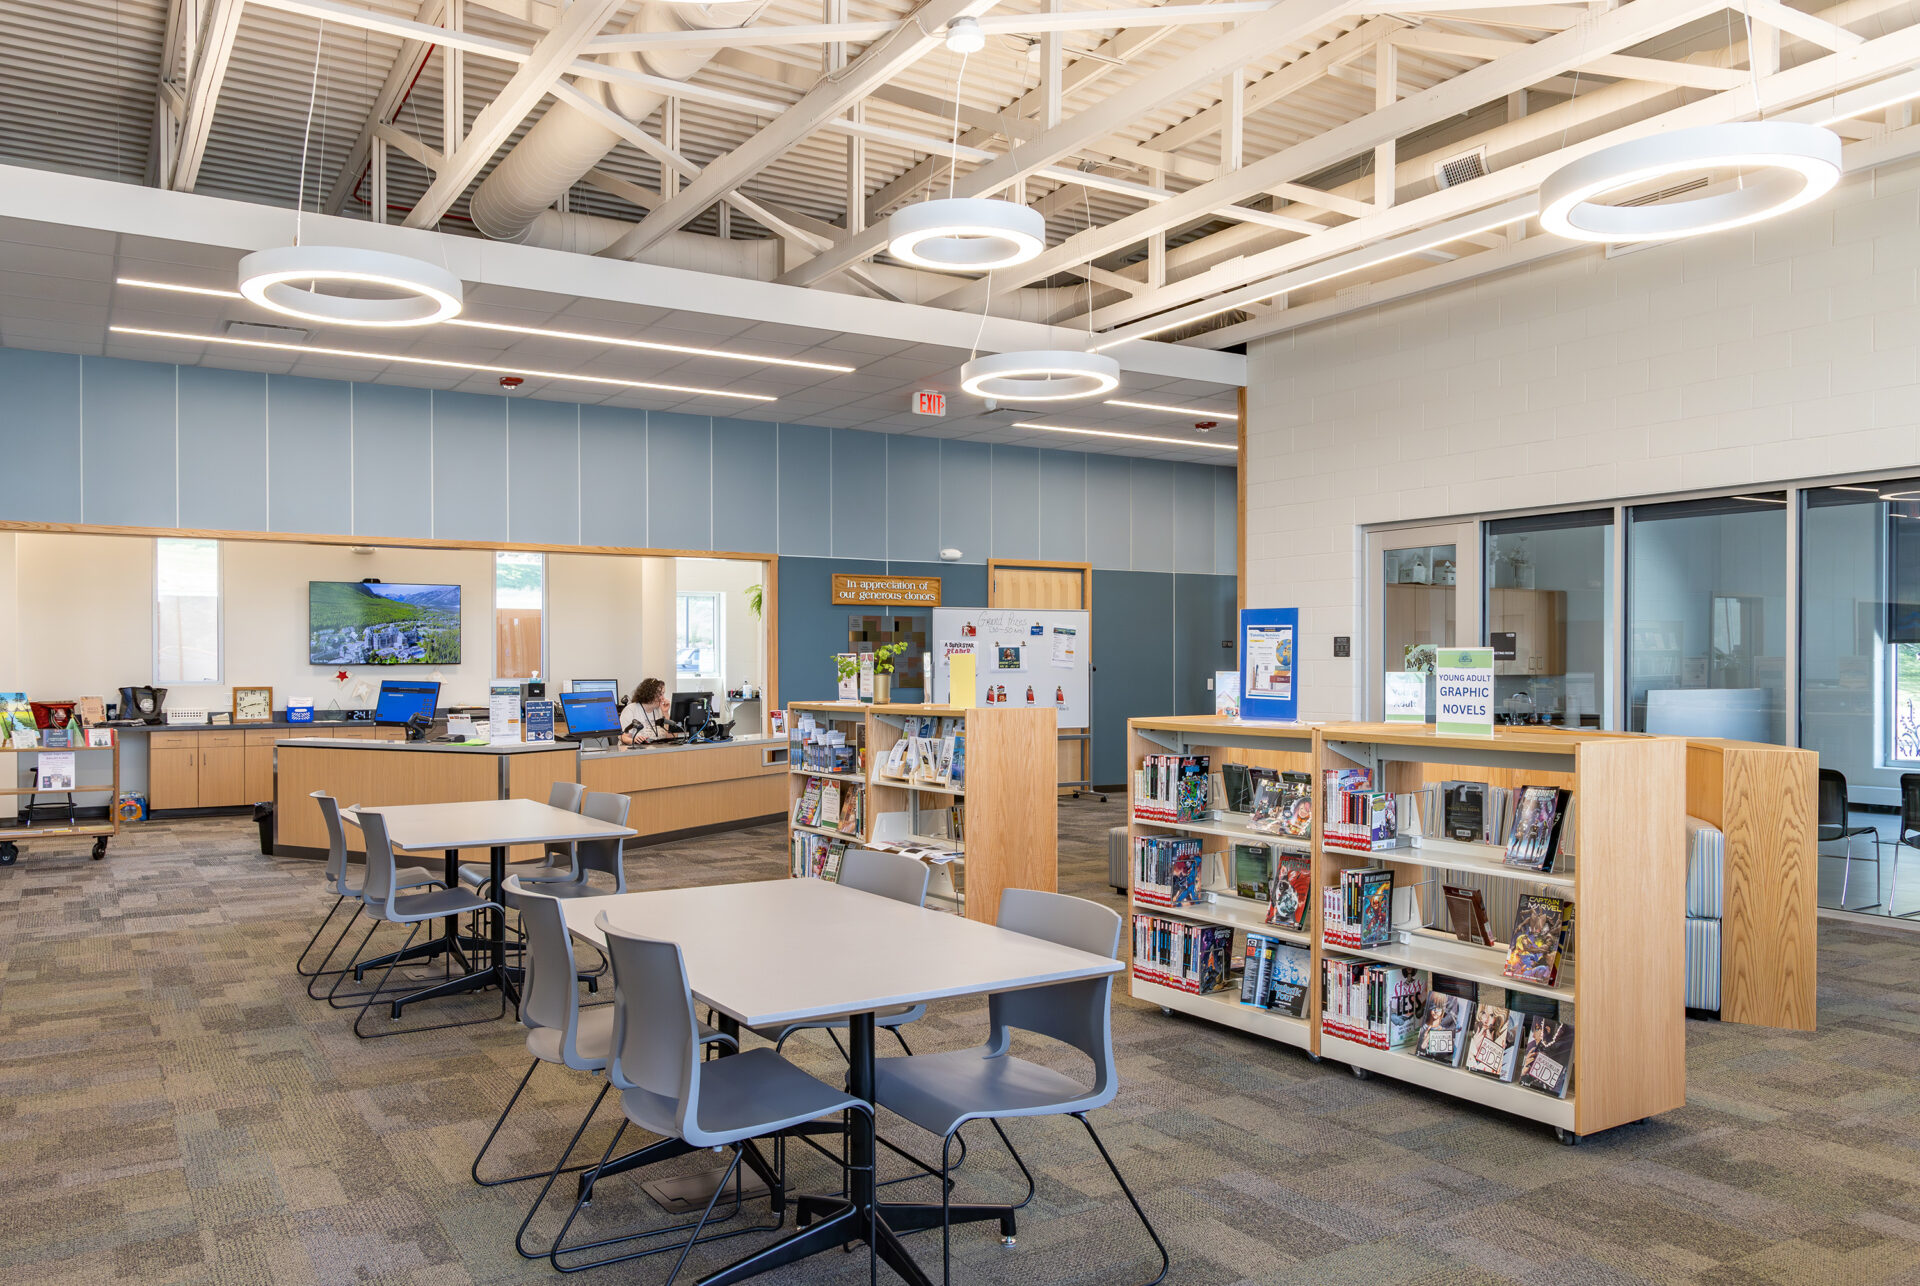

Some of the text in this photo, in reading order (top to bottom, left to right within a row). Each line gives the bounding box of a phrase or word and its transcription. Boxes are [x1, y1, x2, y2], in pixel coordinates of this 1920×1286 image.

[920, 393, 942, 414] EXIT
[847, 579, 929, 591] In appreciation of
[839, 591, 936, 601] our generous donors
[1438, 674, 1491, 682] YOUNG ADULT
[1440, 686, 1489, 698] GRAPHIC
[1442, 704, 1486, 716] NOVELS
[1529, 896, 1560, 905] CAPTAIN
[1527, 902, 1562, 912] MARVEL
[1392, 992, 1422, 1016] LESS
[1430, 1040, 1452, 1052] RIDE
[1478, 1047, 1501, 1069] RIDE
[1531, 1062, 1559, 1086] RIDE
